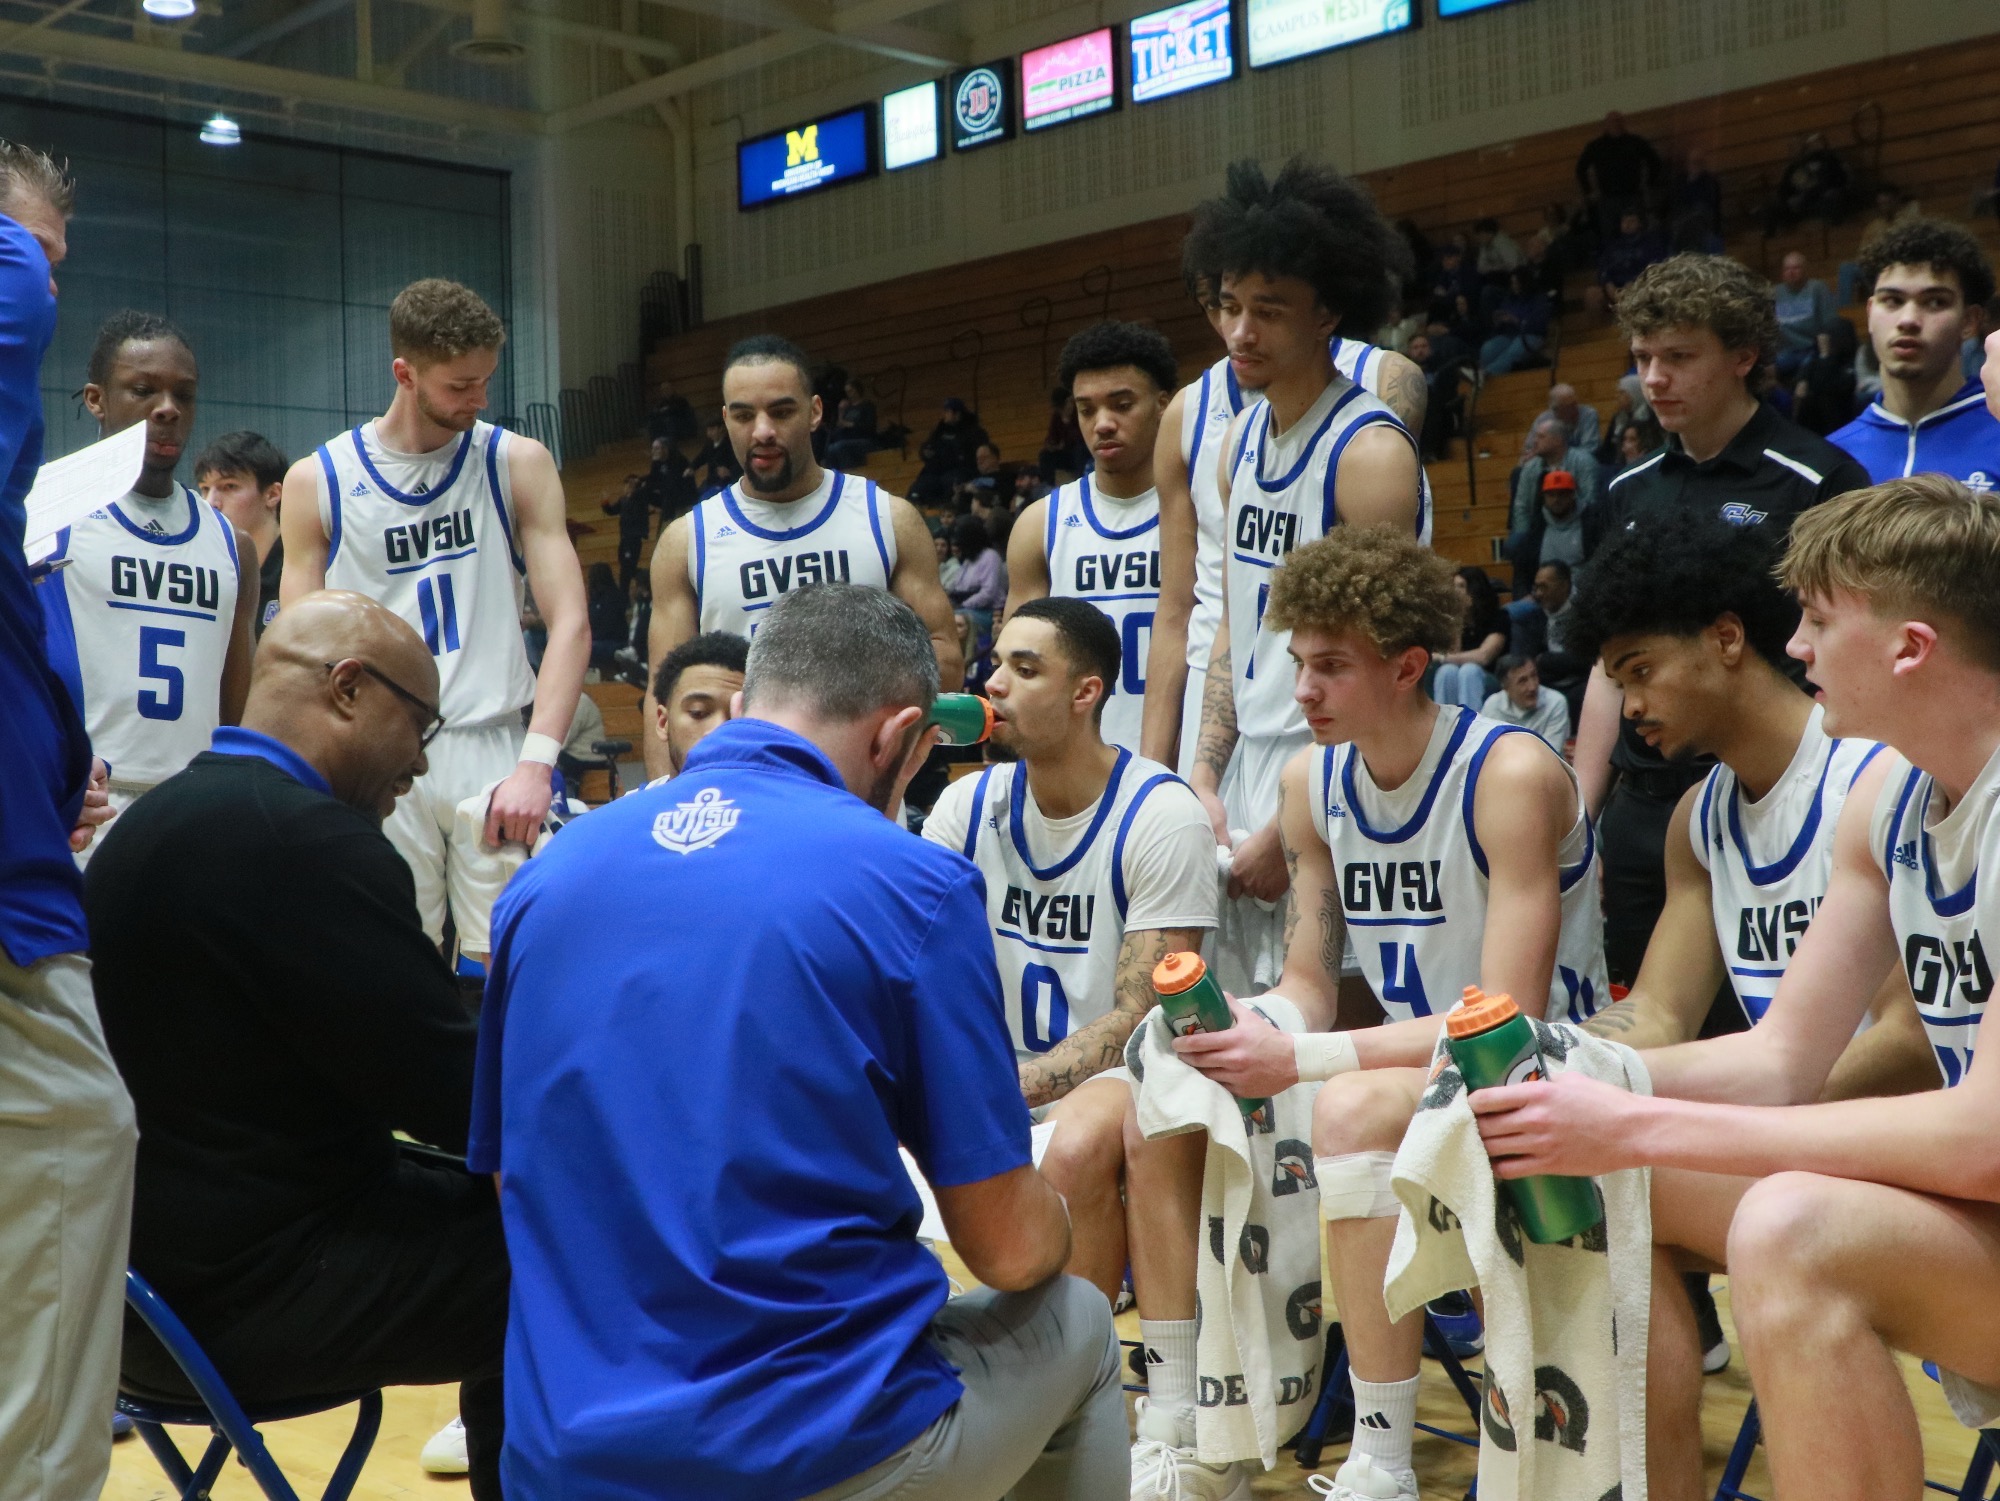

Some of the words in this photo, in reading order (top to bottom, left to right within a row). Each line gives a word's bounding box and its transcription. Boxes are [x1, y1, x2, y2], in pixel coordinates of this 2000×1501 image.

[1132, 11, 1230, 82] TICKET
[1253, 11, 1320, 42] CAMPUS
[1324, 0, 1369, 25] WEST
[1059, 65, 1107, 92] PIZZA
[786, 124, 819, 167] M
[384, 508, 475, 564] GVSU
[111, 555, 219, 610] GVSU
[740, 550, 850, 600] GVSU
[137, 626, 186, 722] 5
[1001, 884, 1095, 942] GVSU
[1344, 860, 1444, 912] GVSU
[1021, 961, 1070, 1053] 0
[1380, 941, 1434, 1019] 4
